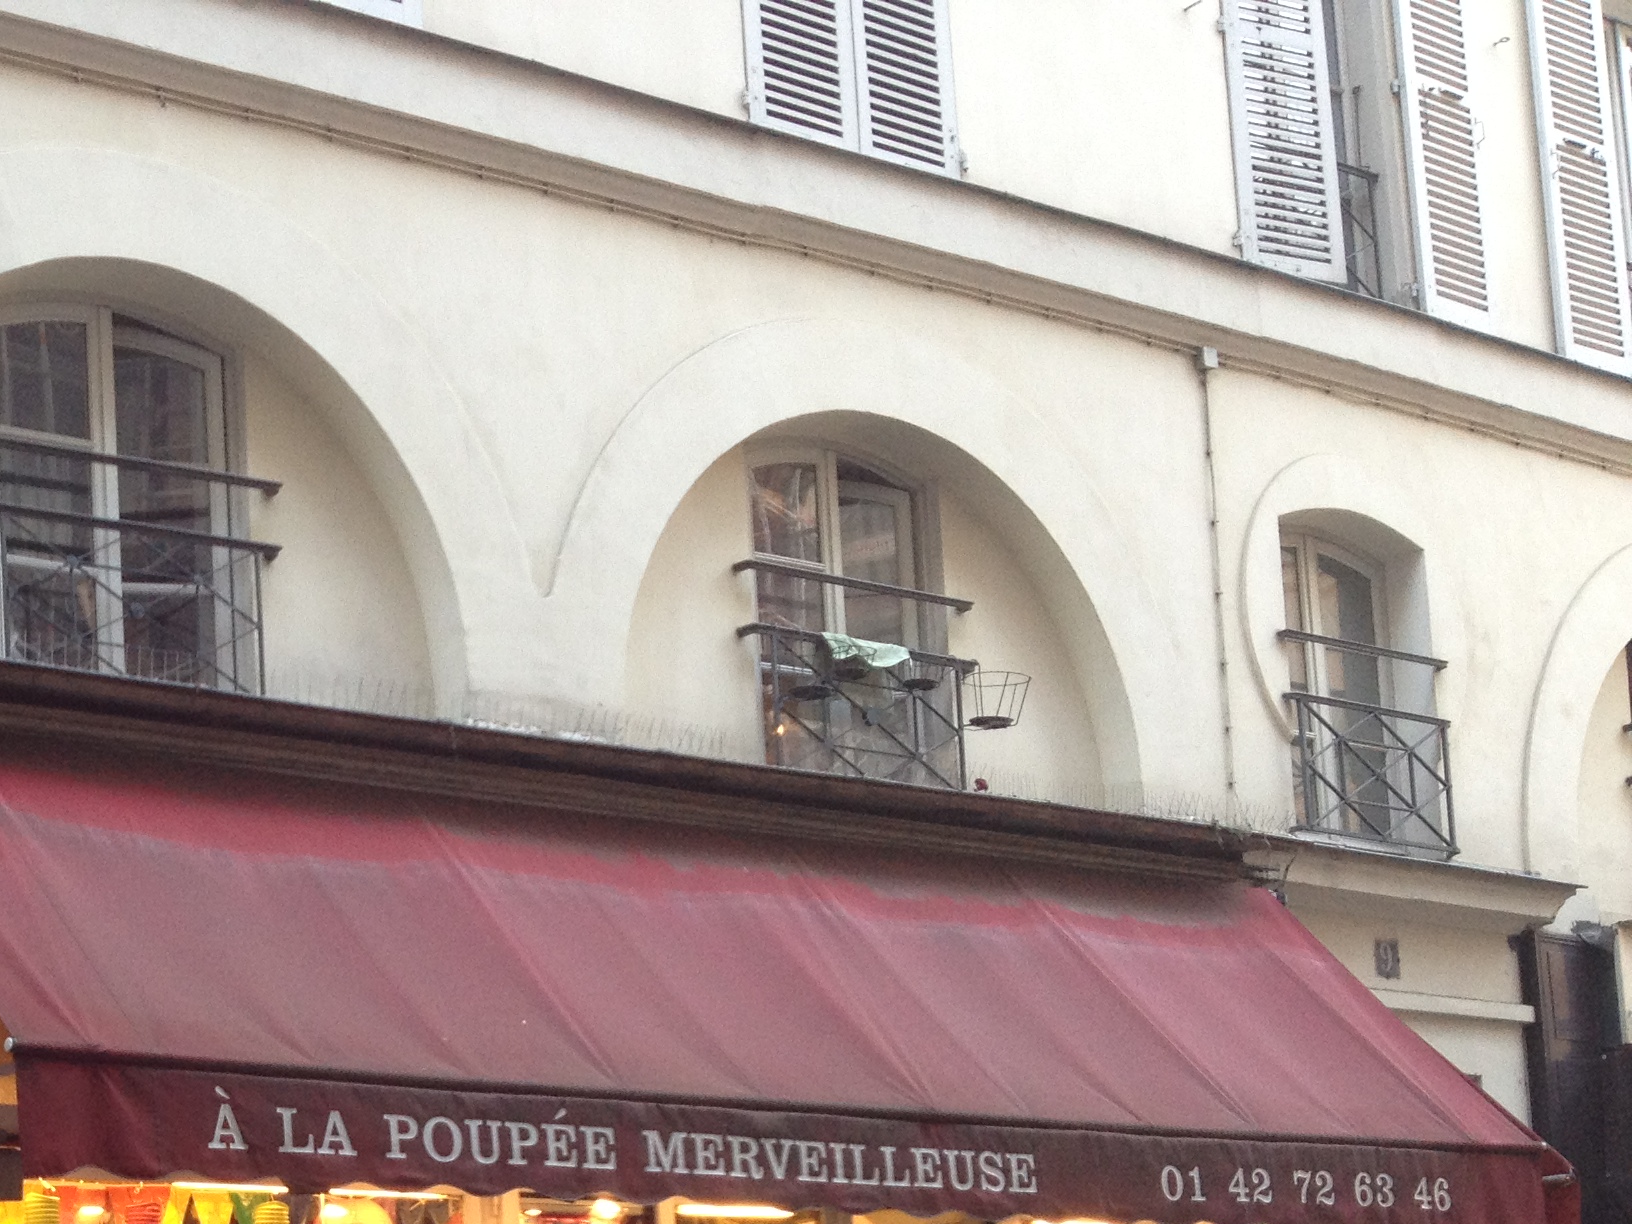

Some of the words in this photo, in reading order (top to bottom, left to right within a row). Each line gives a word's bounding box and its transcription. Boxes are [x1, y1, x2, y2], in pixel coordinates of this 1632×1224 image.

[208, 1086, 248, 1151] À
[276, 1106, 358, 1157] LA
[383, 1108, 618, 1170] POUPÉE
[642, 1129, 1038, 1195] MERVEILLEUSE
[1160, 1164, 1207, 1203] 01
[1226, 1165, 1274, 1205] 42
[1293, 1168, 1337, 1206] 72
[1353, 1170, 1397, 1210] 63
[1412, 1174, 1452, 1213] 46
